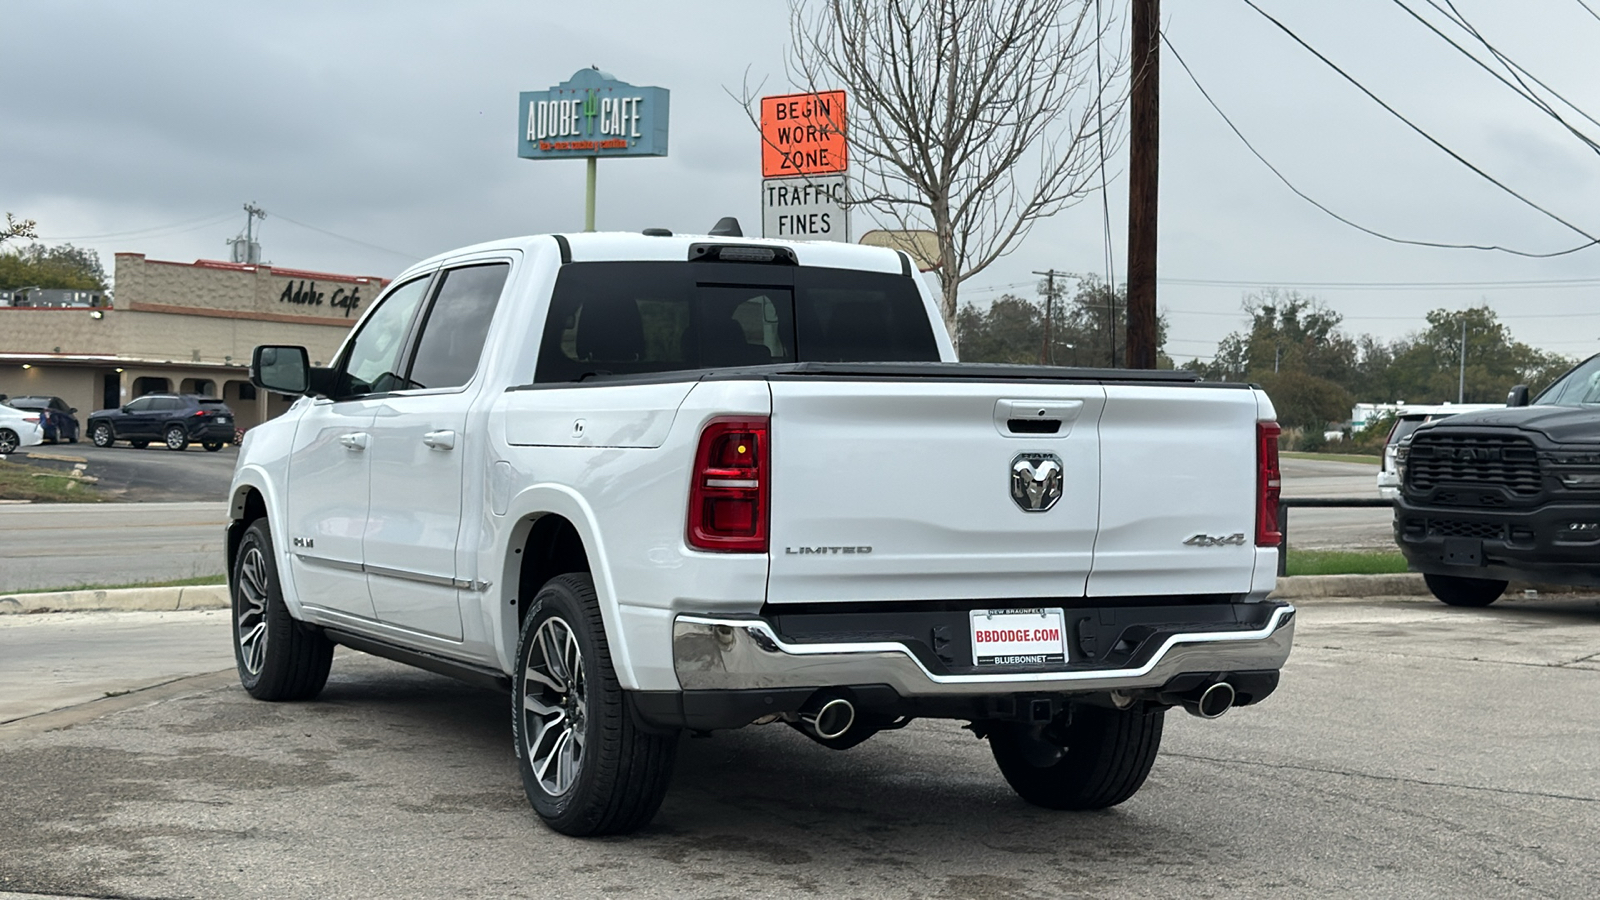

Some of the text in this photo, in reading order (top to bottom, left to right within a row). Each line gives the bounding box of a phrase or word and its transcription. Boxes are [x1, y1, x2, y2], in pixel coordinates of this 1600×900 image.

[526, 97, 643, 141] ADOBE CAFE
[776, 99, 831, 121] BEGIN
[778, 124, 831, 145] WORK
[781, 149, 831, 170] ZONE
[768, 183, 844, 207] TRAFFIC
[779, 213, 831, 235] FINES
[280, 280, 361, 318] Adobe Cafe
[785, 546, 873, 555] LIMITED
[976, 629, 1059, 642] BBDODGE.COM
[995, 655, 1046, 664] BLUEBONNET
